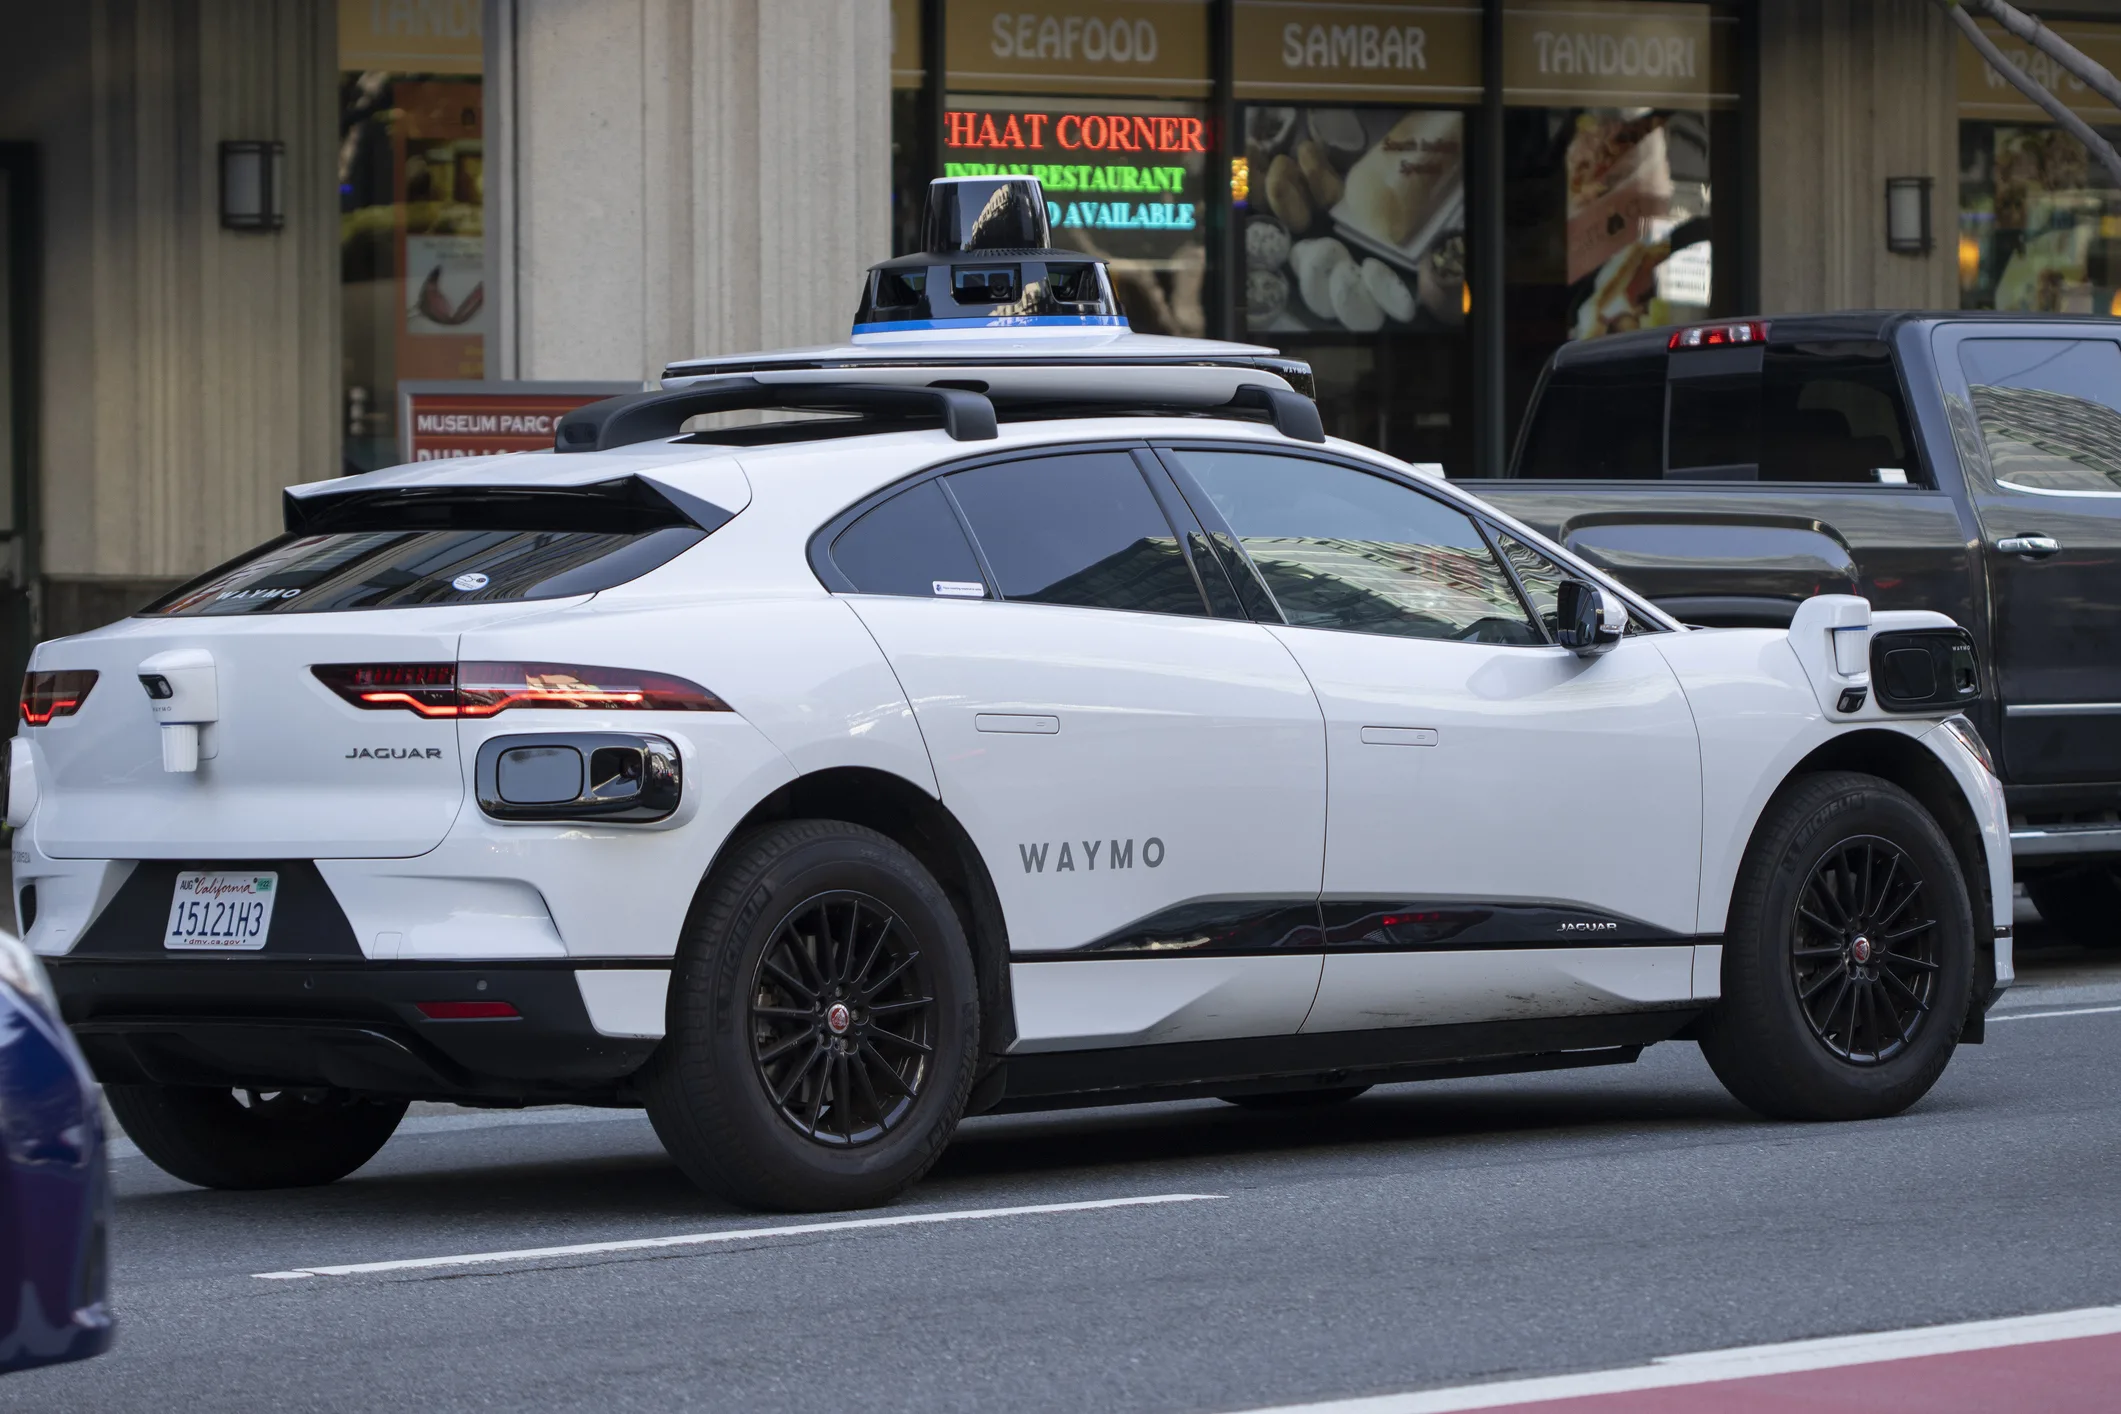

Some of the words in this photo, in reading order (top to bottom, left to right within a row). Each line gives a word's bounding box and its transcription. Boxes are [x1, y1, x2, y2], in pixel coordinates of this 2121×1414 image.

[991, 13, 1158, 62] SEAFOOD
[1283, 23, 1427, 69] SAMBAR
[1533, 31, 1696, 77] TANDOORI
[944, 112, 1048, 149] HAAT
[1056, 115, 1205, 151] CORNER
[1032, 164, 1186, 193] RESTAURANT
[1063, 202, 1196, 229] AVAILABLE
[1283, 366, 1307, 375] WAYMO
[417, 415, 496, 432] MUSEUM
[500, 416, 549, 432] PARC
[216, 588, 301, 600] WAYMO
[345, 747, 442, 759] JAGUAR
[1019, 837, 1165, 873] WAYMO
[180, 880, 193, 890] AUG
[195, 877, 256, 900] California
[172, 901, 264, 937] 15121H3
[1557, 922, 1618, 932] JAGUAR
